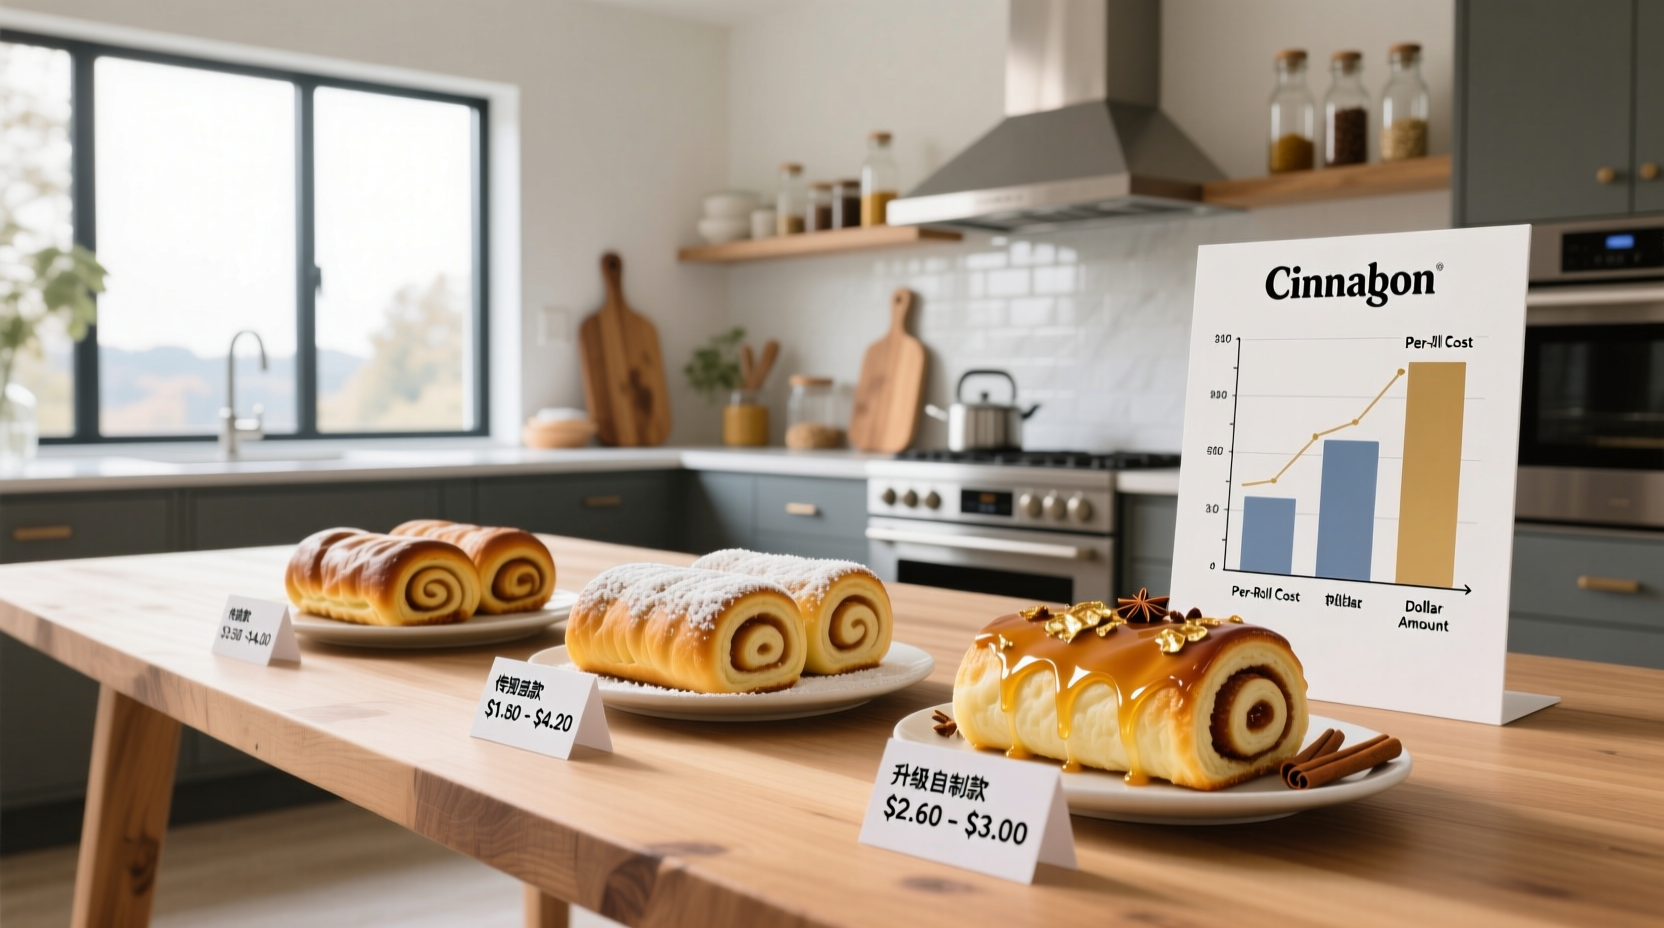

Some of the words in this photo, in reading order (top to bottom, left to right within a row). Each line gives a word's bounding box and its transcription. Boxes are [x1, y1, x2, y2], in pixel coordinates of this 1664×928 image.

[1445, 335, 1474, 348] Cost
[1231, 585, 1273, 600] Per-Roll
[1274, 587, 1301, 603] Cost
[1405, 599, 1444, 614] Dollar
[1397, 616, 1450, 632] Amount
[533, 708, 573, 732] $4.20
[890, 763, 990, 802] 升级自制款
[883, 794, 943, 827] $2.60
[964, 810, 1028, 845] $3.00
